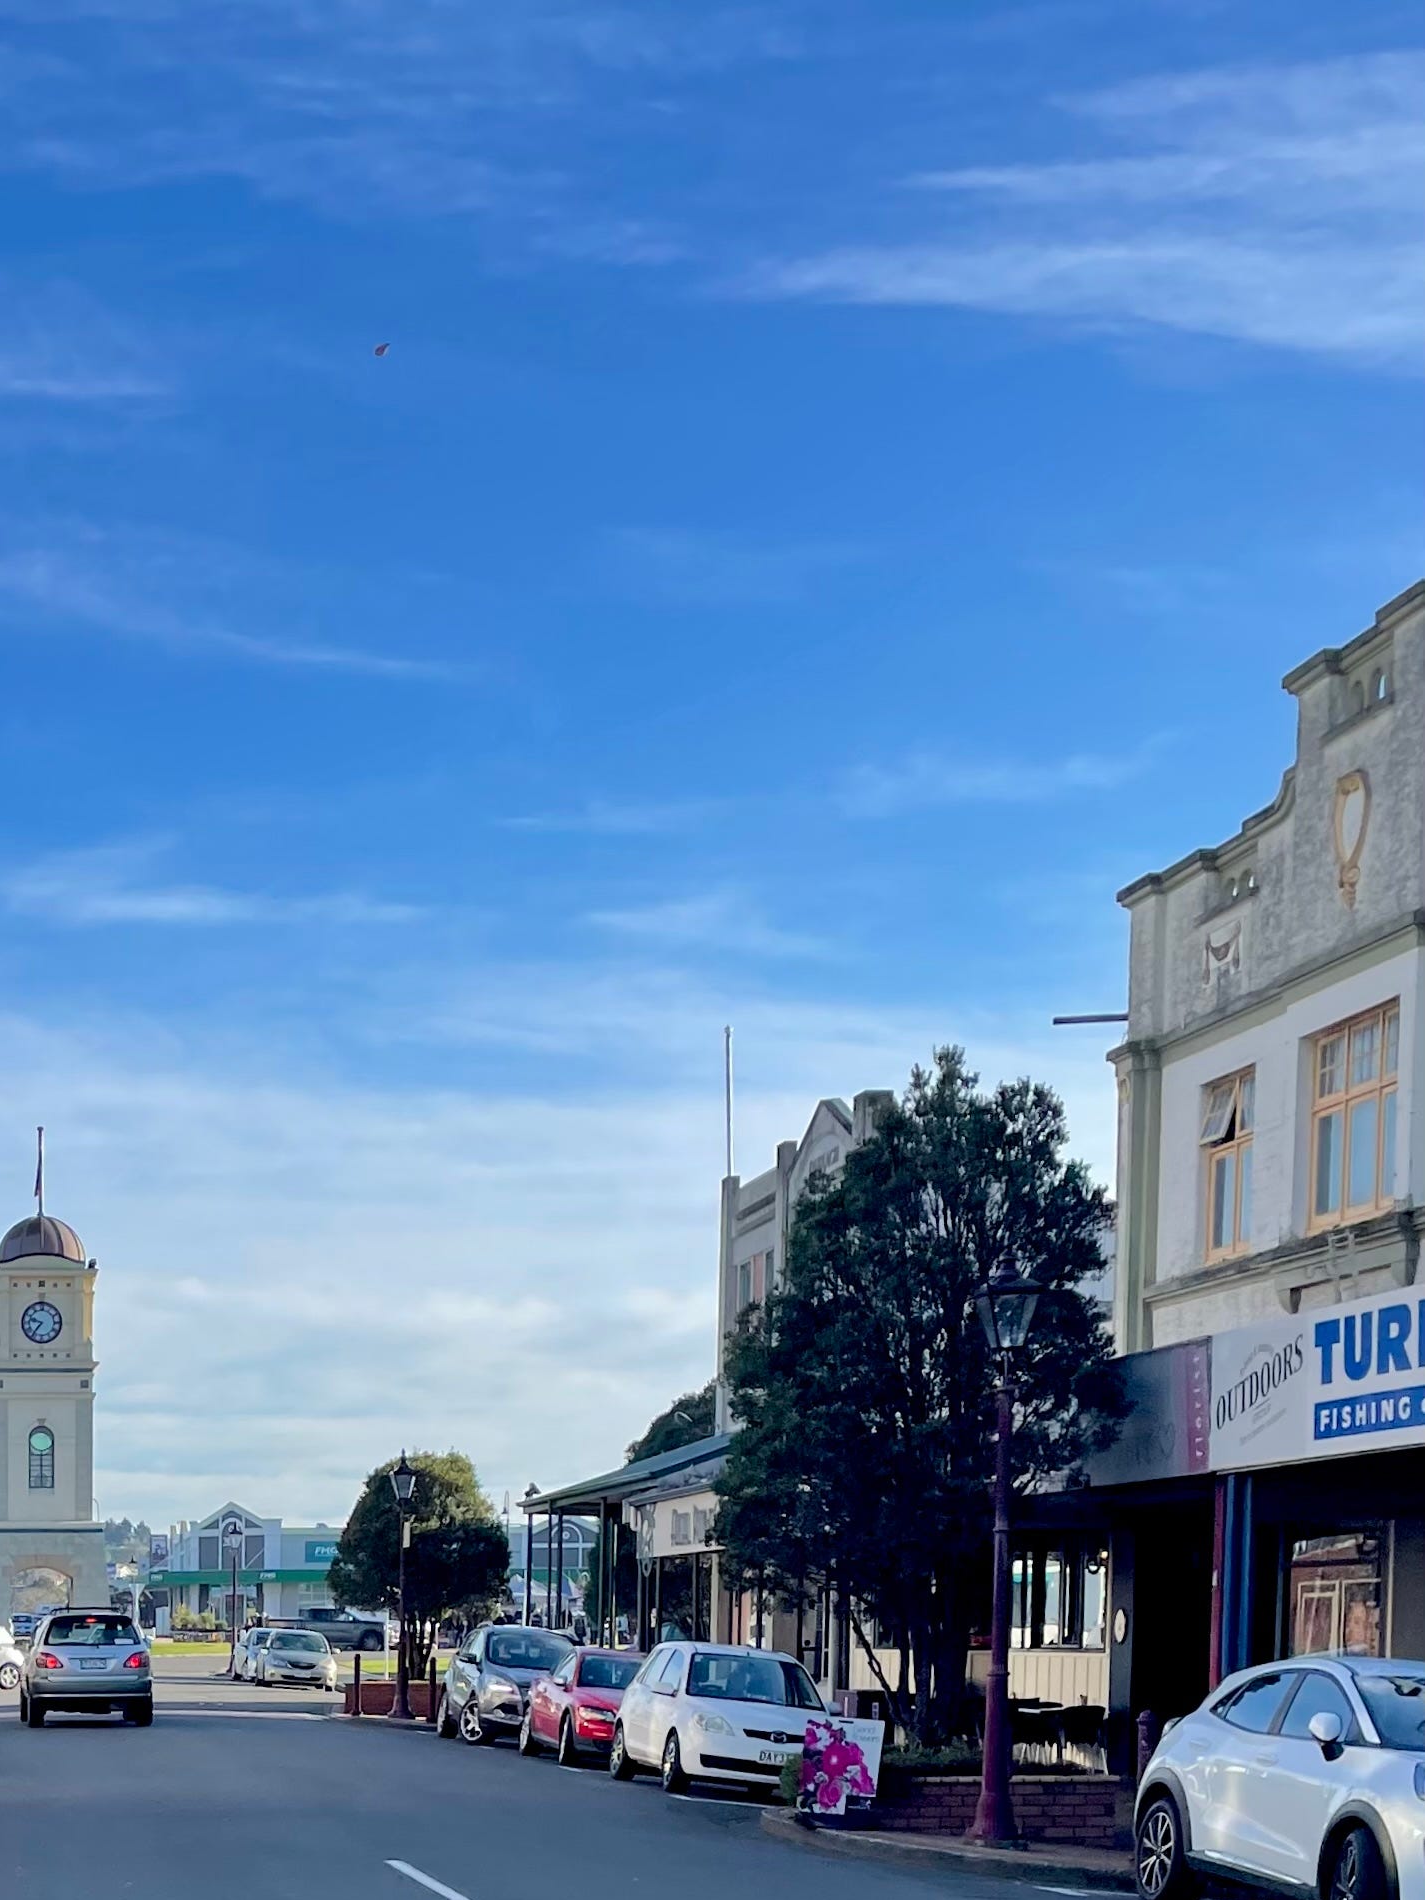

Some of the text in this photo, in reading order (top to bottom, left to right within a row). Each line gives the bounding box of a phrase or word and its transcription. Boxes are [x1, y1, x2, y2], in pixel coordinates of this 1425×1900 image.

[1216, 1334, 1304, 1431] OUTDOORS
[1314, 1300, 1425, 1386] TUR
[1319, 1396, 1412, 1432] FISHING
